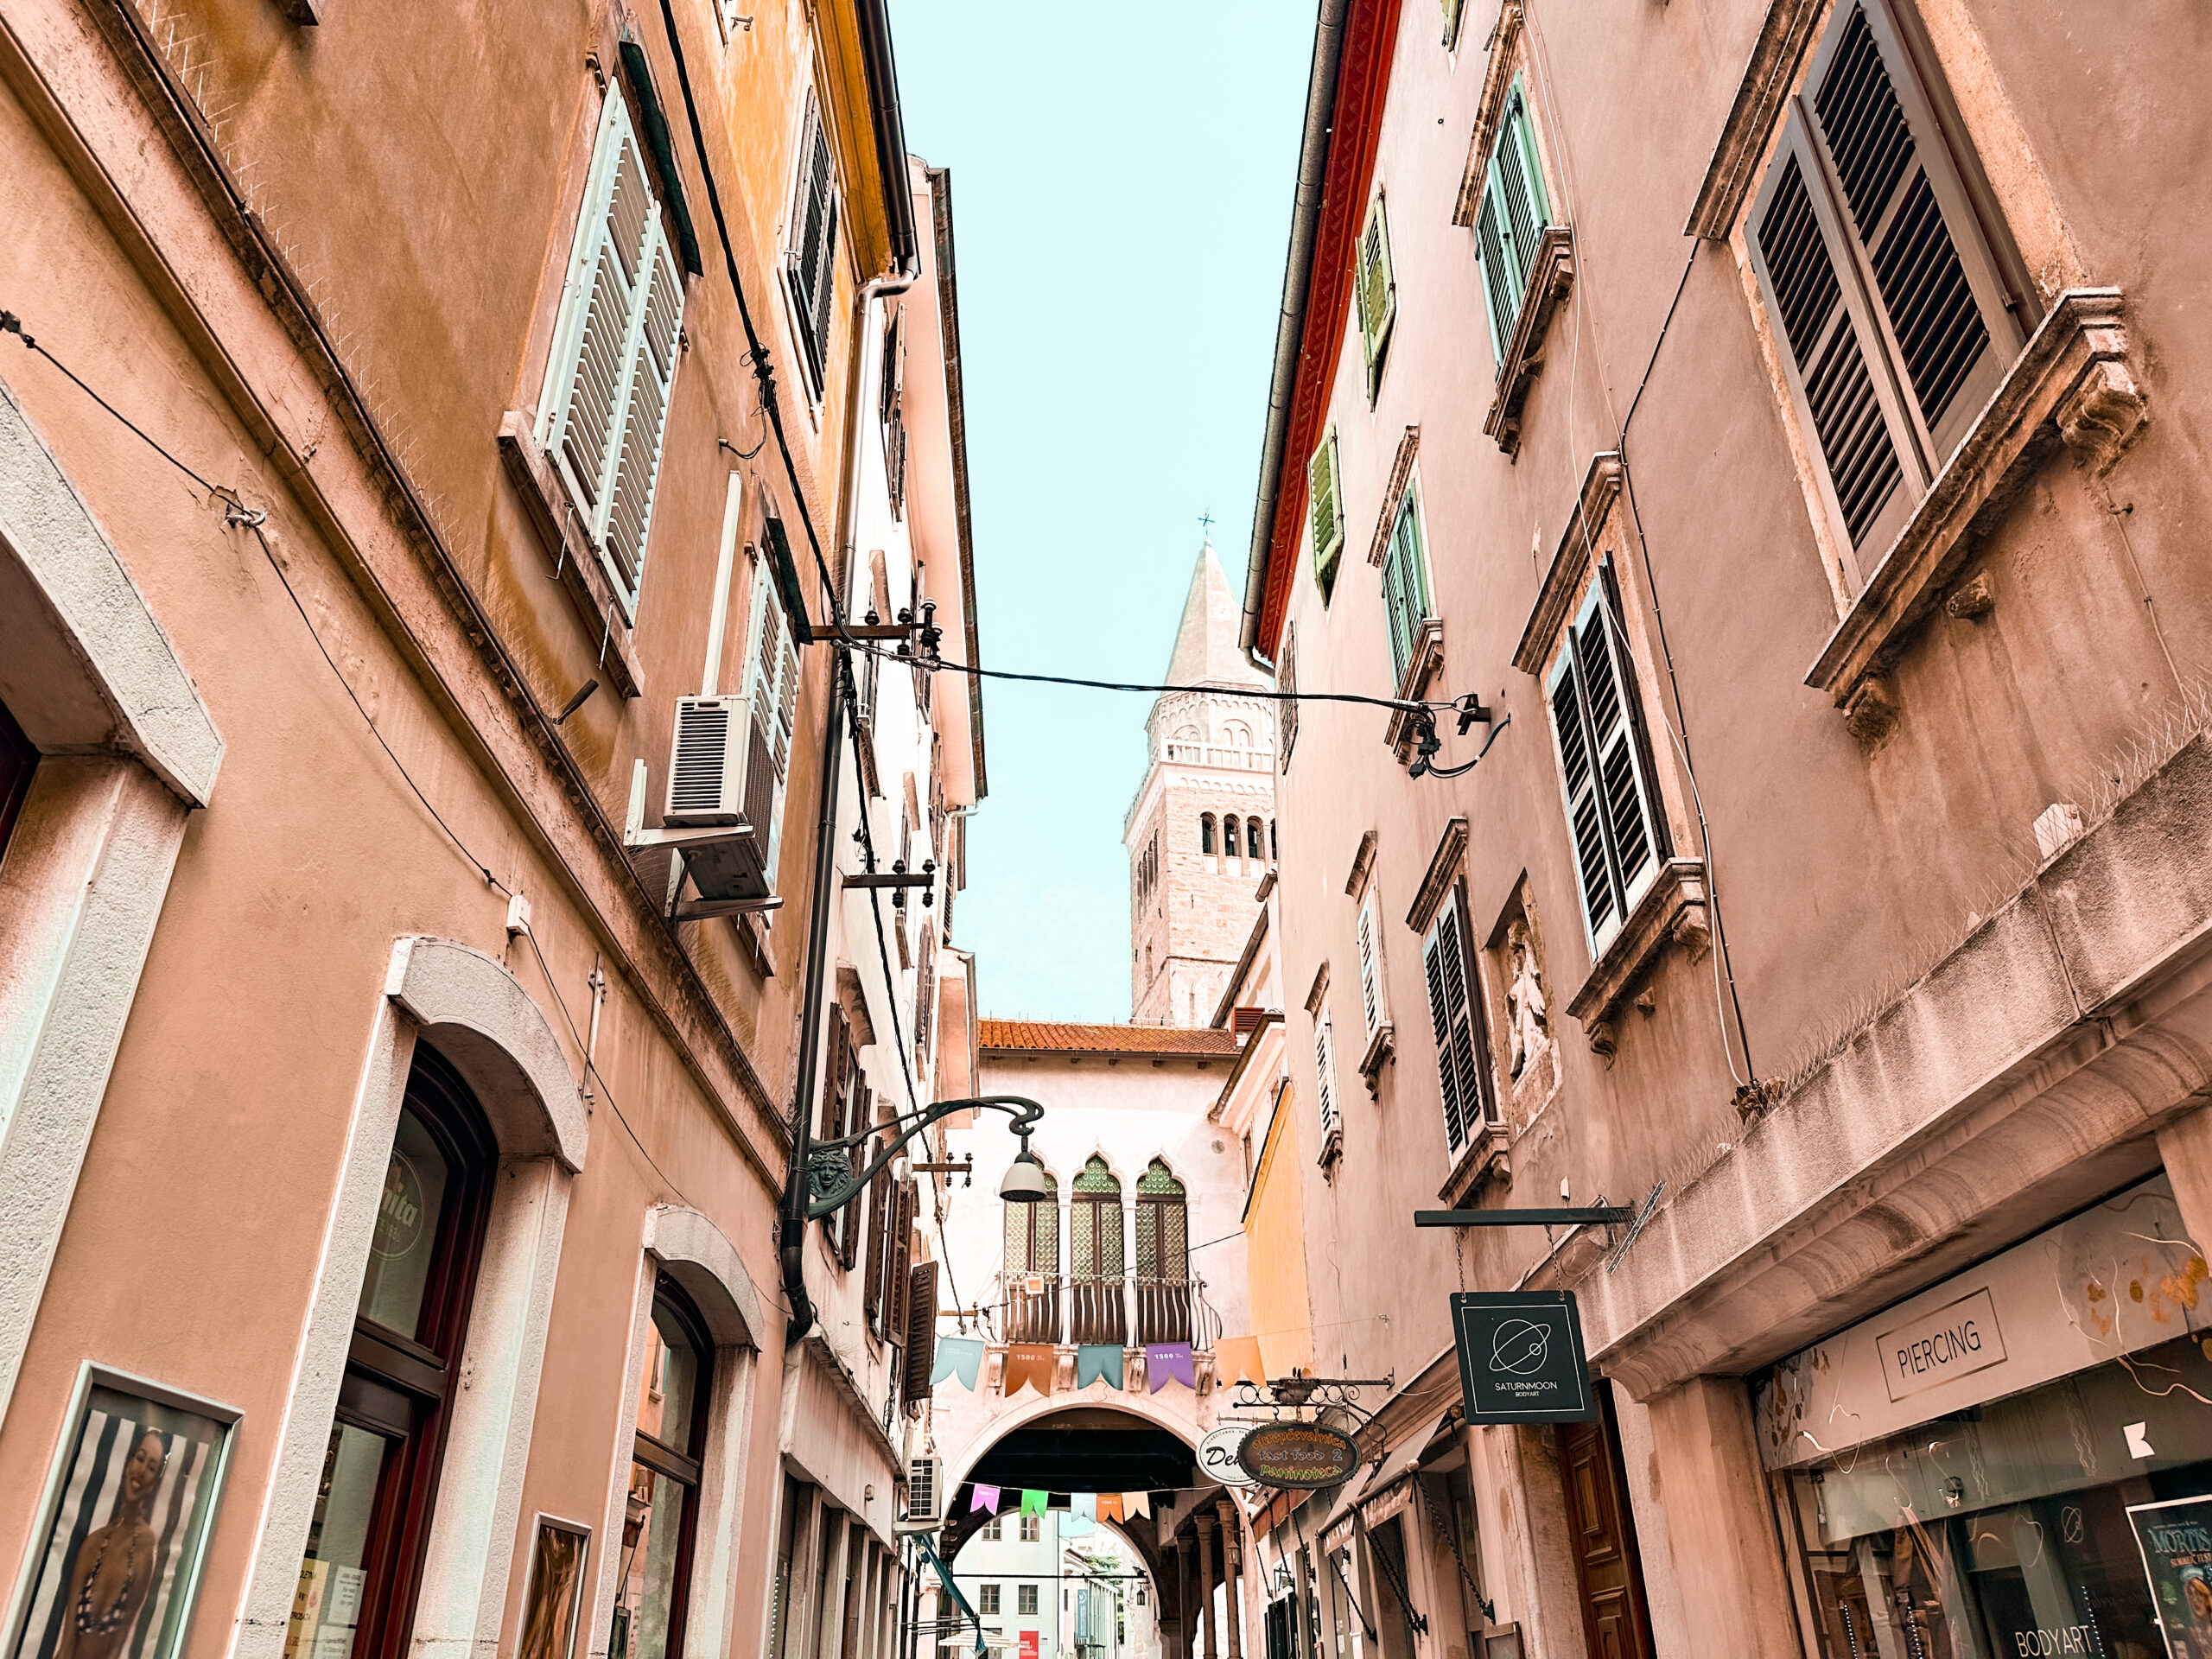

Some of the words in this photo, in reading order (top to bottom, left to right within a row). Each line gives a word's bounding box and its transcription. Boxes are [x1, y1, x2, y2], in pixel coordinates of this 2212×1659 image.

[1897, 1320, 1981, 1378] PIERCING
[1495, 1382, 1558, 1391] SATURNMOON
[1258, 1447, 1288, 1461] fast
[1290, 1447, 1325, 1461] food
[1332, 1448, 1343, 1461] 2
[2146, 1528, 2211, 1556] MORTIS
[2015, 1624, 2092, 1657] BODYART
